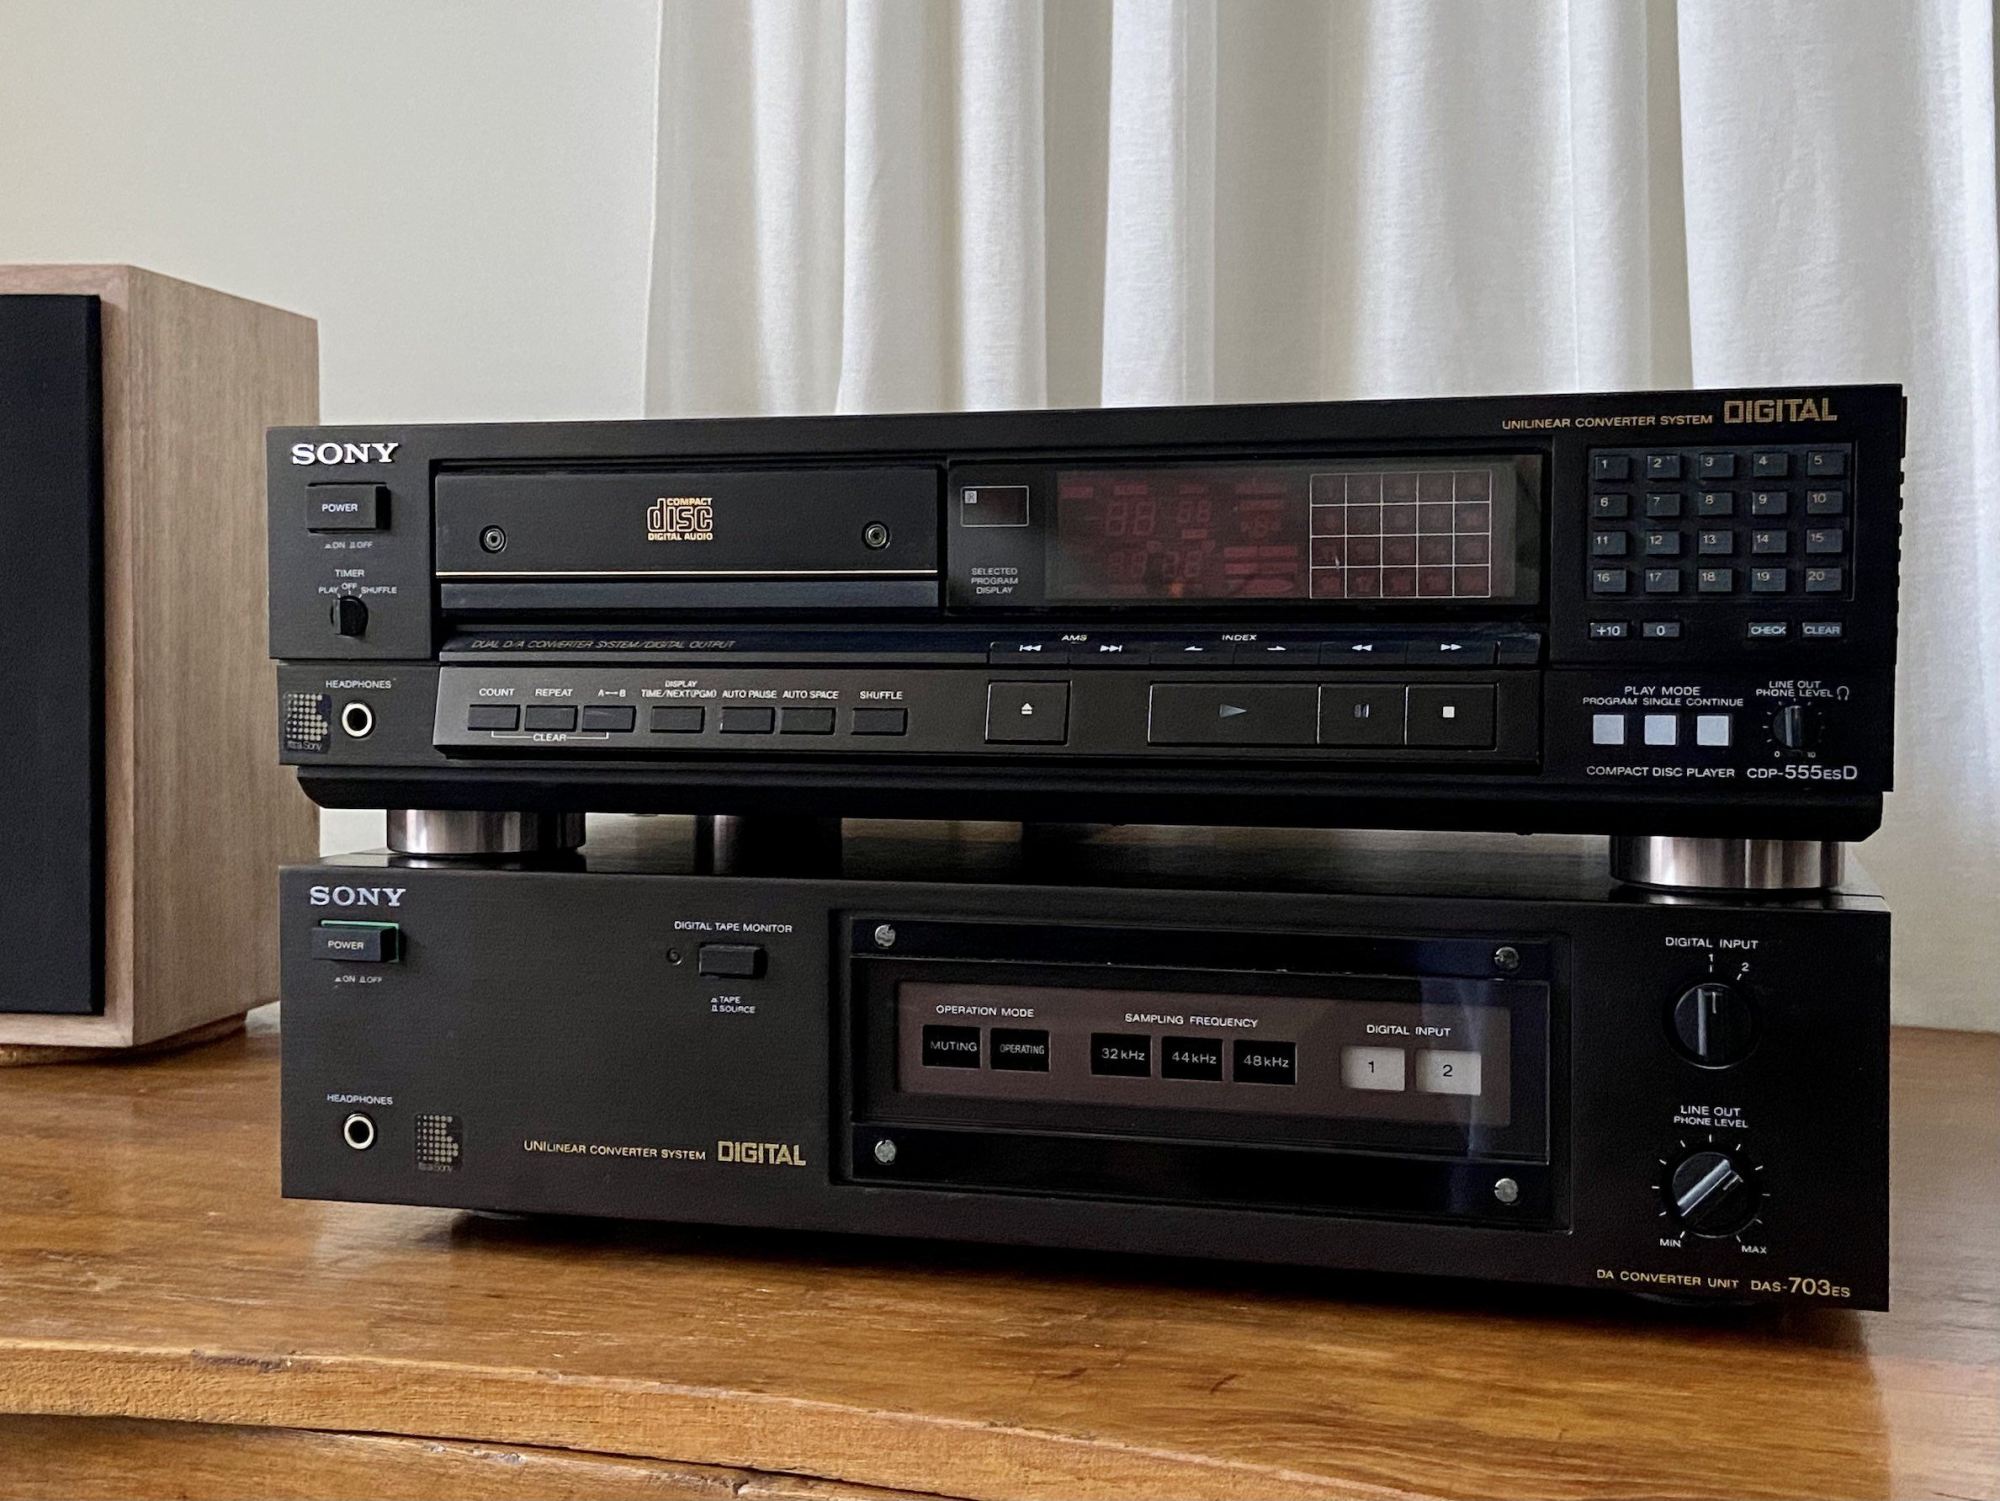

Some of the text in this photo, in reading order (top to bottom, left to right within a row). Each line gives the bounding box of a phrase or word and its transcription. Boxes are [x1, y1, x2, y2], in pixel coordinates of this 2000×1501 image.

[1724, 399, 1838, 424] DIGITAL
[1502, 414, 1713, 430] UNILINEAR CONVERTER SYSTEM
[292, 442, 398, 465] SONY
[1602, 460, 1607, 468] 1
[1654, 459, 1662, 468] 2
[1705, 458, 1713, 467] 3
[1758, 456, 1766, 466] 4
[1814, 456, 1822, 465] 5
[1600, 498, 1608, 507] 6
[1654, 497, 1660, 507] 7
[1706, 495, 1713, 504] 8
[1758, 494, 1766, 504] 9
[1812, 494, 1826, 503] 10
[322, 504, 358, 512] POWER
[647, 498, 713, 532] disc
[1597, 536, 1608, 545] 11
[1650, 535, 1663, 545] 12
[1703, 535, 1716, 544] 13
[1756, 534, 1769, 543] 14
[1811, 533, 1824, 543] 15
[335, 569, 364, 577] TIMER
[1597, 573, 1610, 582] 16
[1649, 573, 1661, 582] 17
[1702, 572, 1715, 581] 18
[1756, 571, 1769, 581] 19
[1808, 571, 1824, 581] 20
[971, 577, 1018, 585] PROGRAM
[361, 586, 397, 594] SHUFFLE
[976, 587, 1013, 595] DISPLAY
[1597, 626, 1620, 635] +10
[1751, 626, 1786, 635] CHECK
[1804, 626, 1839, 634] CLEAR
[1062, 634, 1087, 642] AMS
[689, 640, 736, 648] OUTPUT
[326, 680, 391, 689] HEADPHONES
[1769, 681, 1794, 689] LINE
[479, 688, 514, 696] COUNT
[535, 689, 573, 697] REPEAT
[722, 690, 777, 699] AUTO PAUSE
[782, 691, 839, 699] AUTO SPACE
[860, 691, 902, 699] SHUFFLE
[1624, 687, 1701, 696] PLAY MODE
[1756, 689, 1833, 698] PHONE LEVEL
[1583, 698, 1638, 706] PROGRAM
[1642, 698, 1681, 706] SINGLE
[1686, 698, 1744, 707] CONTINUE
[1587, 766, 1735, 778] COMPACT DISC PLAYER
[310, 886, 406, 906] SONY
[674, 922, 793, 934] DIGITAL TAPE MONITOR
[328, 941, 364, 949] POWER
[1665, 937, 1758, 950] DIGITAL INPUT
[1709, 954, 1749, 971] 1 2
[719, 1005, 756, 1013] SOURCE
[936, 1006, 1034, 1018] OPERATION MODE
[1125, 1013, 1257, 1029] SAMPLING FREQUENCY
[1366, 1024, 1450, 1037] DIGITAL INPUT
[930, 1041, 978, 1053] MUTING
[1000, 1044, 1045, 1056] OPERATING
[1368, 1061, 1374, 1073] 1
[1443, 1065, 1453, 1077] 2
[327, 1094, 393, 1105] HEADPHONES
[1680, 1105, 1741, 1117] LINE OUT
[1674, 1116, 1748, 1128] PHONE LEVEL
[524, 1140, 706, 1161] UNILINEAR CONVERTER SYSTEM
[718, 1141, 806, 1166] DIGITAL
[1660, 1239, 1681, 1247] MIN
[1741, 1245, 1767, 1254] MAX
[1597, 1269, 1850, 1297] DA CONVERTER UNIT DAS-703ES
